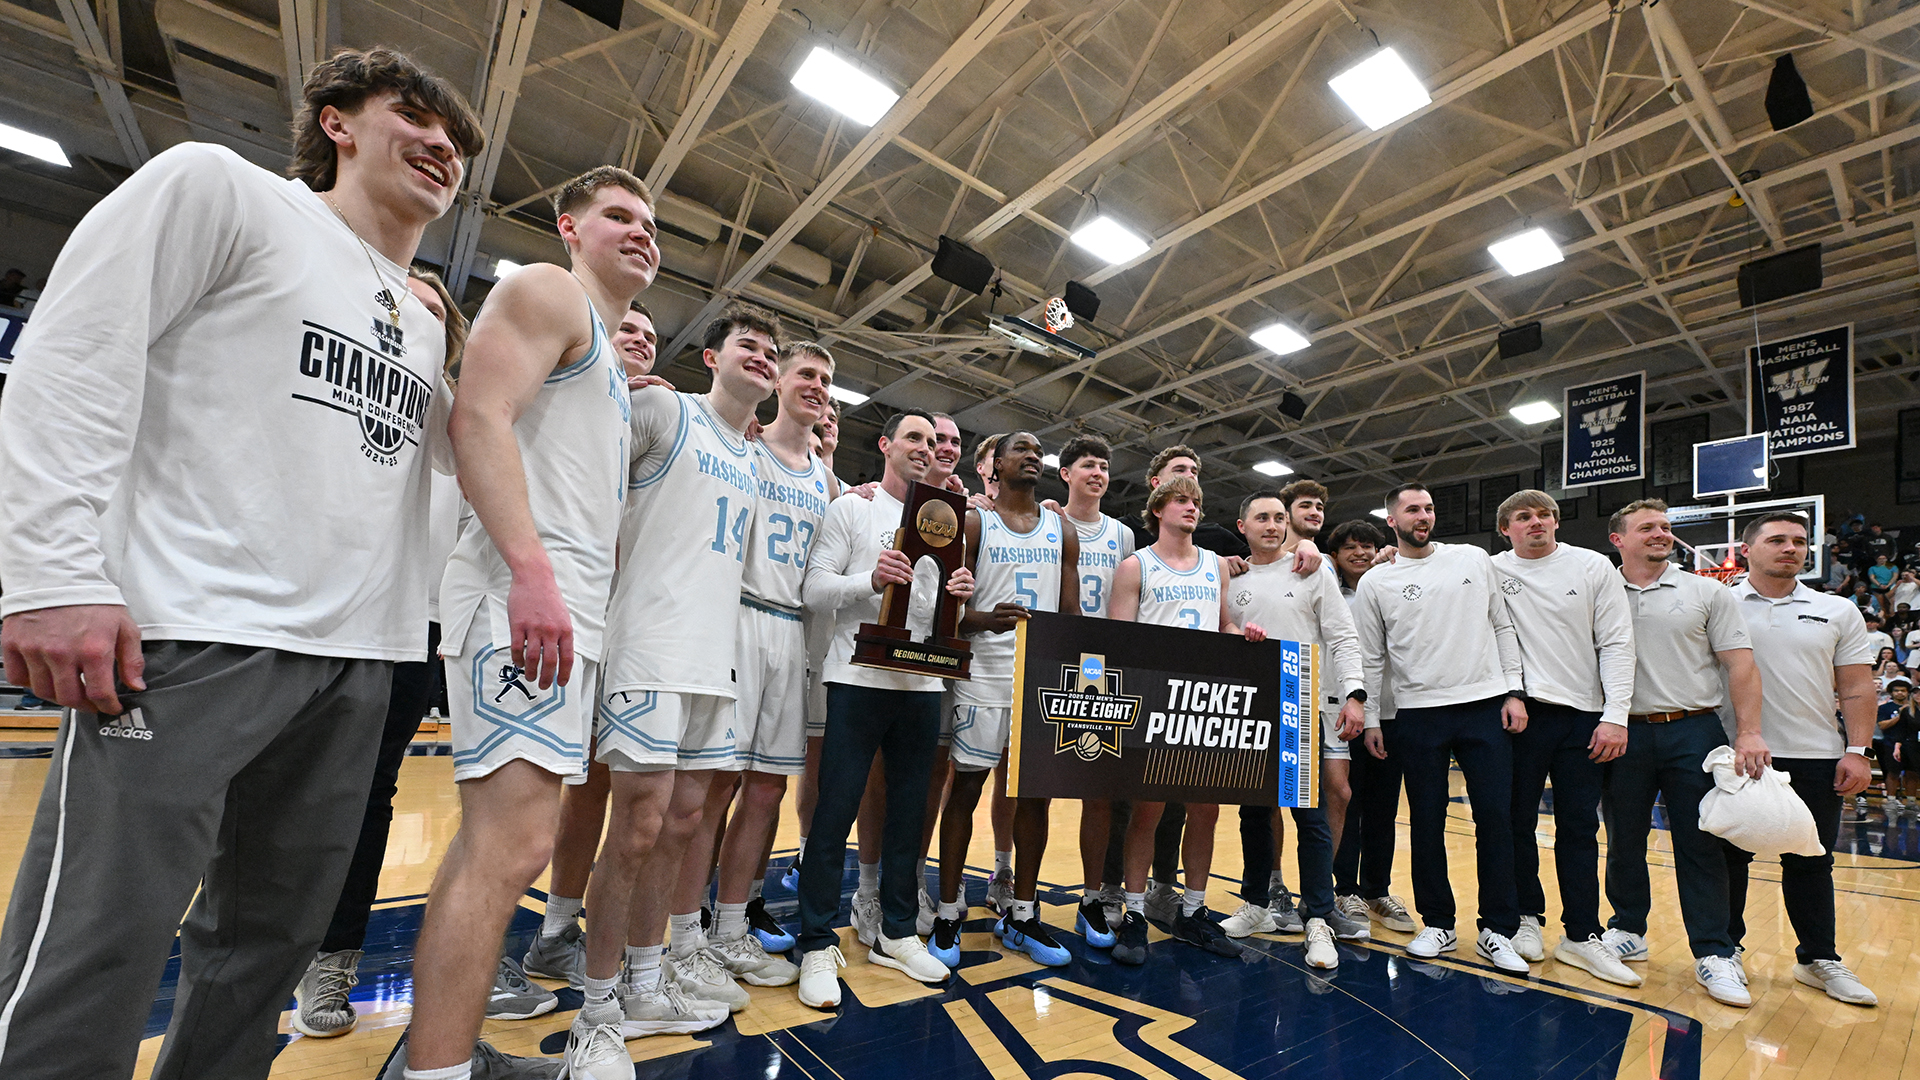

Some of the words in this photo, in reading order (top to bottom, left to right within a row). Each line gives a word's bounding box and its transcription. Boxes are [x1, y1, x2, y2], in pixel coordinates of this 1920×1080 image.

[1757, 343, 1840, 367] BASKETBALL
[1778, 339, 1818, 354] MEN'S
[1588, 385, 1618, 396] MEN'S
[1767, 375, 1830, 393] WASHBURN
[332, 388, 364, 409] MIAA
[1572, 389, 1635, 407] BASKETBALL
[1782, 401, 1814, 414] 1987
[1579, 415, 1627, 429] WASHBURN
[1780, 412, 1817, 426] NAIA
[1768, 421, 1838, 439] ATIONAL
[1590, 437, 1615, 448] 1925
[360, 442, 398, 467] 2024-25
[1590, 447, 1615, 458] AAU
[1569, 463, 1637, 480] CHAMPIONS
[1573, 455, 1632, 470] NATIONAL
[757, 477, 826, 516] WASHBURN
[919, 517, 957, 540] NCAA
[767, 512, 815, 569] 23
[988, 547, 1059, 564] WASHBURN
[1078, 551, 1117, 569] HBURN
[1015, 572, 1038, 610] 5
[1152, 585, 1217, 603] WASHBURN
[892, 648, 927, 661] REGIONAL
[927, 653, 959, 666] CHAMPION
[1282, 648, 1298, 677] 25
[1083, 667, 1102, 676] NCAA
[1167, 678, 1258, 716] TICKET
[1285, 679, 1295, 699] SEAT
[1050, 698, 1089, 717] ELITE
[1091, 701, 1132, 720] EIGHT
[1282, 701, 1298, 729] 29
[99, 726, 154, 740] adidas
[1067, 722, 1104, 731] EVANSVILLE,
[1145, 711, 1272, 751] PUNCHED
[1285, 730, 1295, 749] ROW
[1281, 750, 1298, 766] 3
[1284, 766, 1294, 802] SECTION
